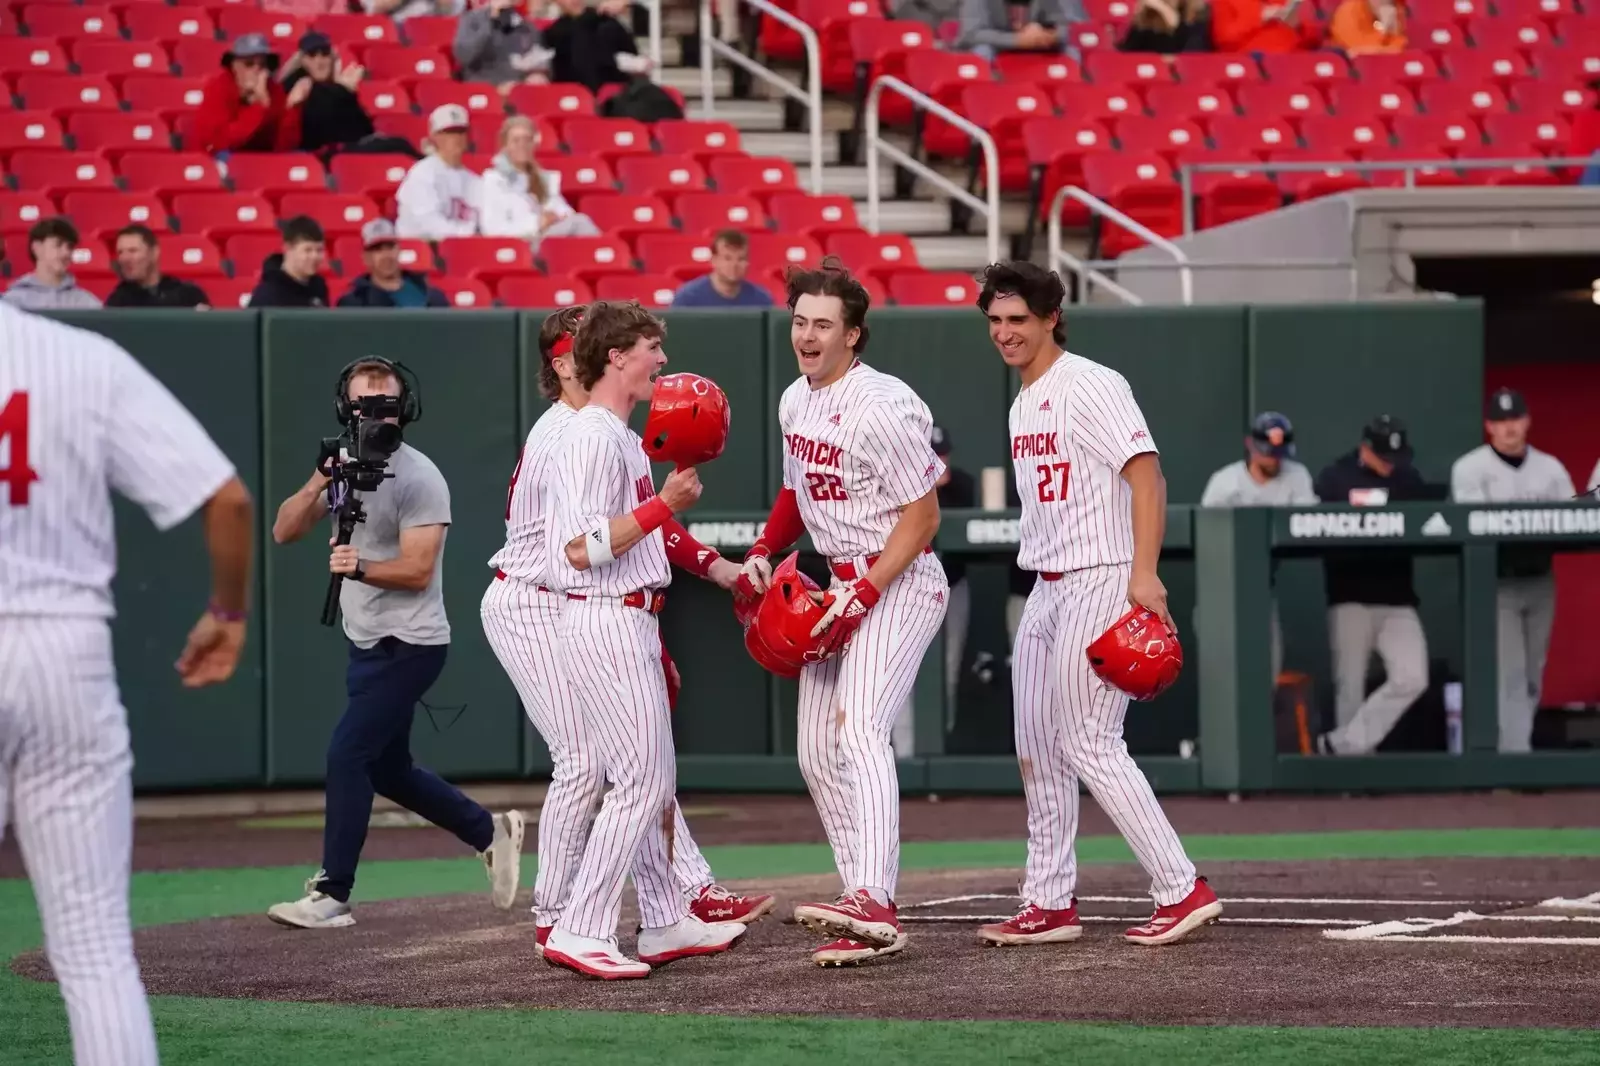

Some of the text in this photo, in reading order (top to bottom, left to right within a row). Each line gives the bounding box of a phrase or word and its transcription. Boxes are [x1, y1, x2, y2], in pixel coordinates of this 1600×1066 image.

[805, 472, 848, 501] 22
[1037, 462, 1070, 503] 27
[1290, 512, 1405, 537] GOPACK.COM
[1468, 508, 1600, 535] @NCSTATEBAS
[667, 532, 681, 548] 13
